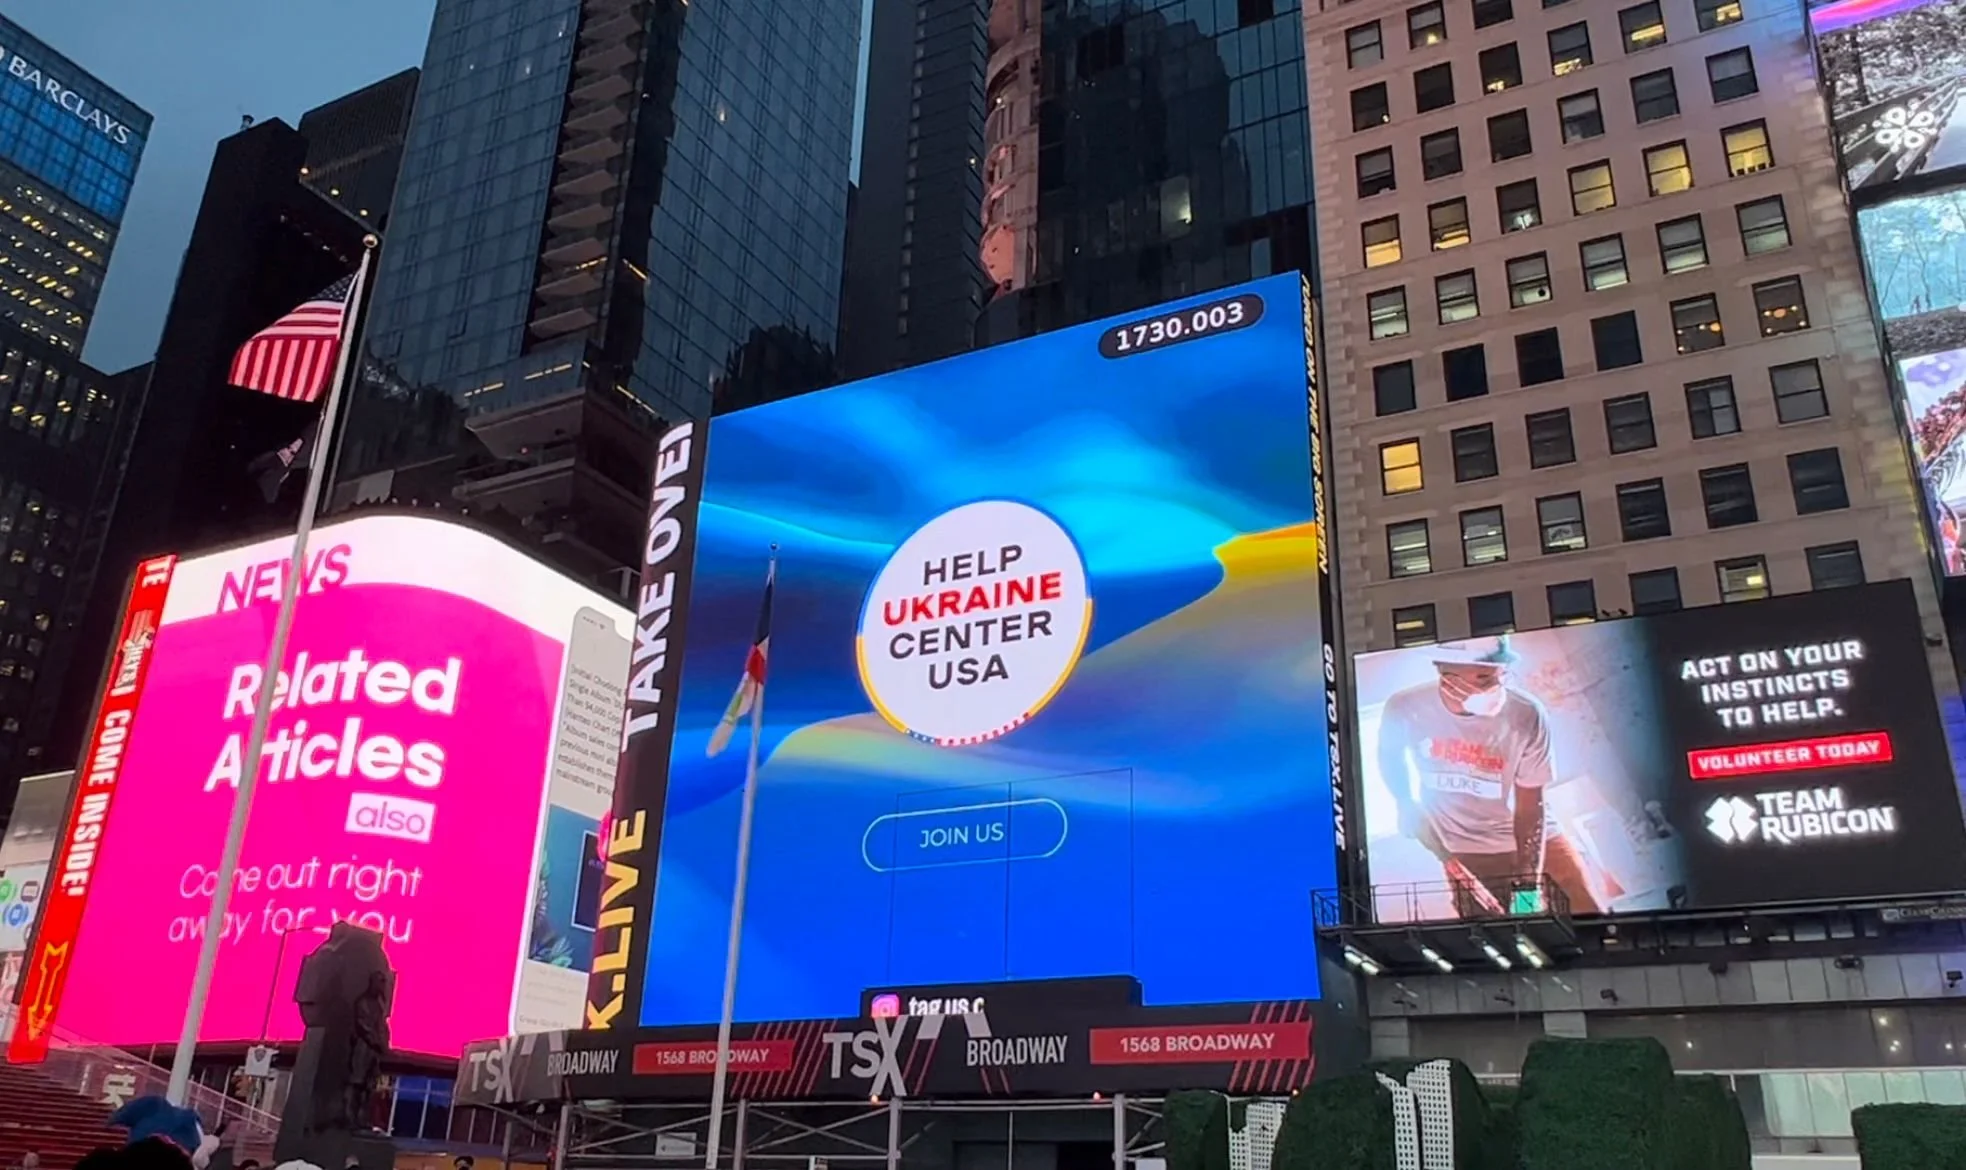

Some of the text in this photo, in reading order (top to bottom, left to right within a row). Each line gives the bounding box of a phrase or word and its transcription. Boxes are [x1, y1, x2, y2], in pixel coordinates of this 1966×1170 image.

[8, 55, 131, 145] BARCLAYS
[1116, 302, 1244, 351] 1730.003
[1305, 347, 1317, 384] ON
[1308, 386, 1320, 434] THE
[1313, 476, 1328, 575] SCREEN
[218, 543, 352, 614] NEWS
[923, 544, 1023, 586] HELP
[883, 572, 1062, 627] UKRAINE
[889, 610, 1053, 660] CENTER
[621, 572, 676, 753] TAKE
[928, 654, 1009, 690] USA
[1323, 643, 1335, 683] GO
[1681, 641, 1863, 680] ACT ON YOUR
[222, 648, 463, 720] Related
[1701, 668, 1851, 704] INSTINCTS
[1326, 689, 1337, 723] TO
[1717, 698, 1844, 728] TO HELP.
[1698, 740, 1880, 771] VOLUNTEER TODAY
[62, 709, 132, 897] COME INSIDE!
[355, 801, 427, 835] also
[1755, 788, 1843, 816] TEAM
[919, 823, 1005, 848] JOIN US
[1760, 806, 1896, 844] RUBICON
[266, 856, 321, 891] out
[327, 855, 423, 901] right
[168, 911, 253, 946] away
[261, 899, 316, 935] for
[656, 1043, 770, 1065] 1568 BRODWAY
[823, 1014, 909, 1097] TSX
[966, 1036, 1067, 1066] BROADWAY
[1120, 1032, 1275, 1053] 1568 BROADWAY
[469, 1037, 519, 1103] TSX
[547, 1049, 619, 1077] BROADWAY
